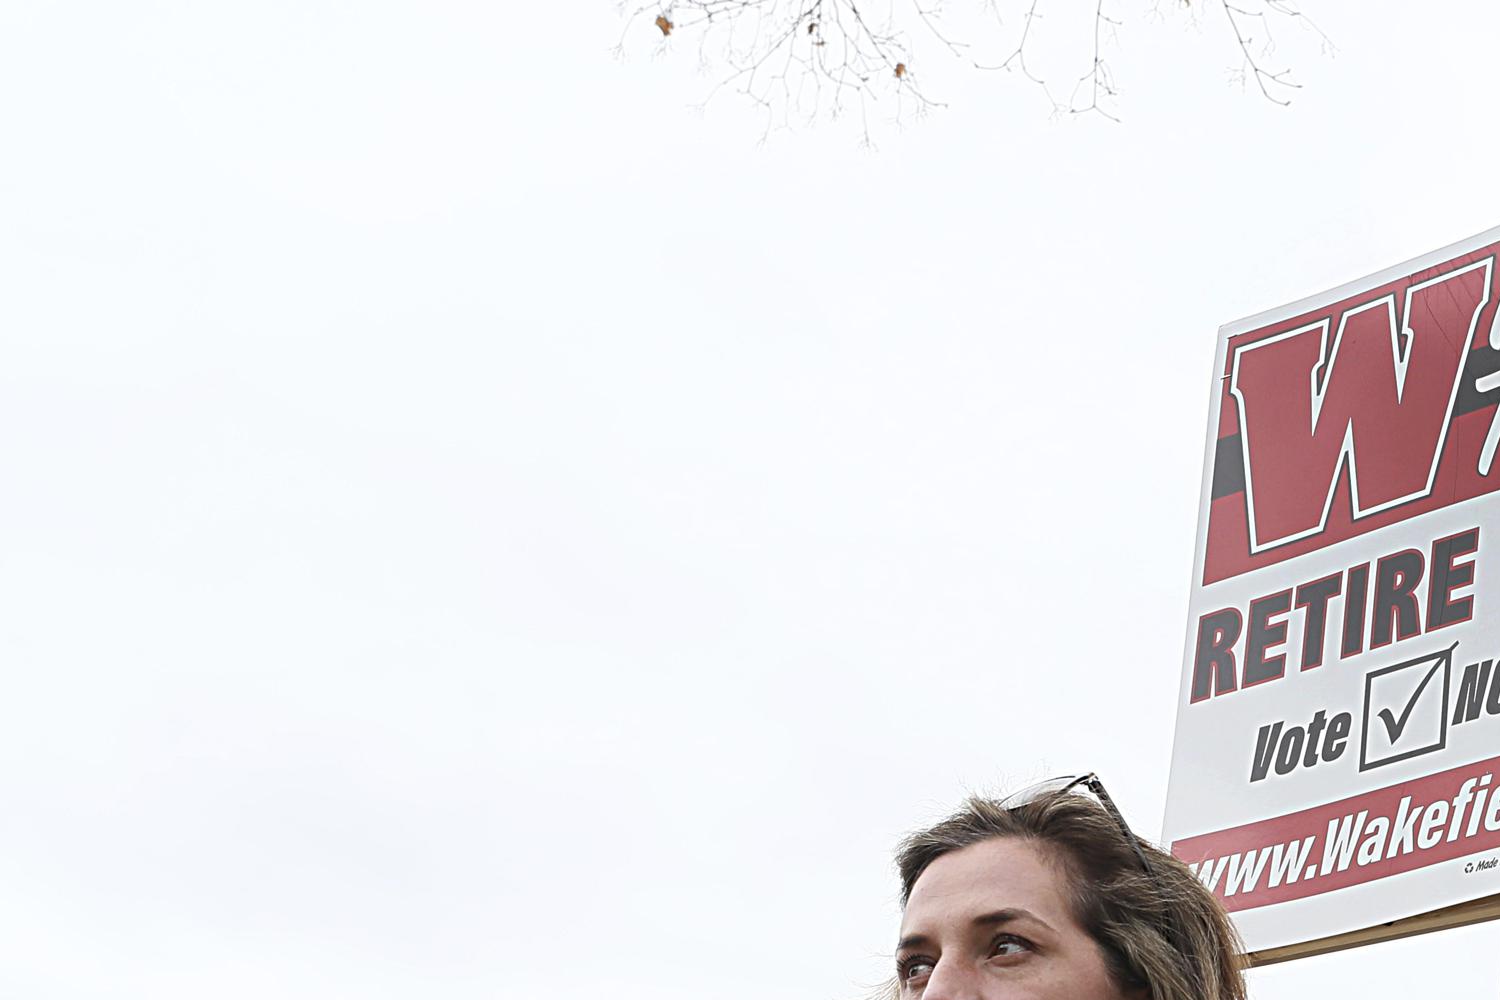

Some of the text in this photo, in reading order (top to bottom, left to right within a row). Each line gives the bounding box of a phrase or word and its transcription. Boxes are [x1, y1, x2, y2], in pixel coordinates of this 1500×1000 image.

[1230, 254, 1494, 555] W
[1190, 527, 1480, 704] RETIRE
[1250, 709, 1352, 783] Vote
[1475, 857, 1499, 872] Made
